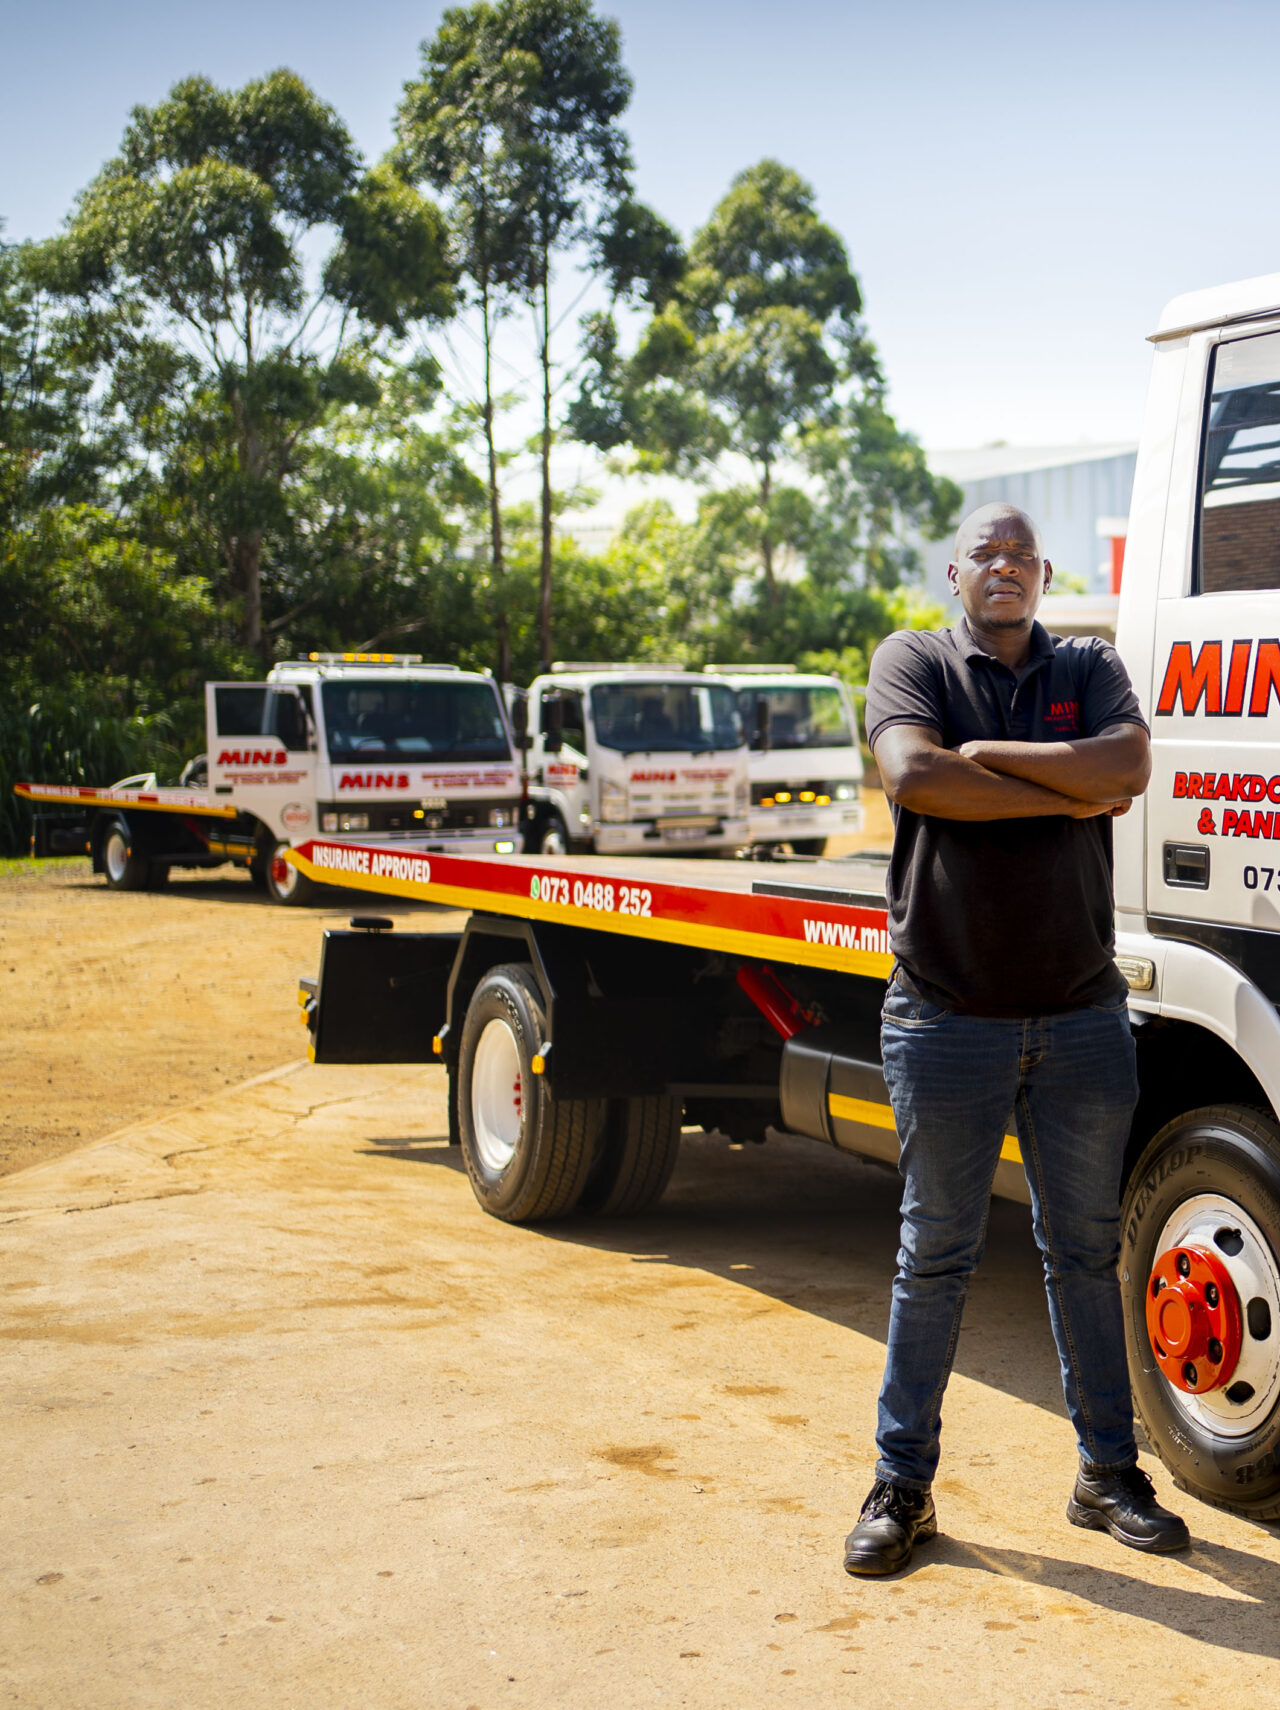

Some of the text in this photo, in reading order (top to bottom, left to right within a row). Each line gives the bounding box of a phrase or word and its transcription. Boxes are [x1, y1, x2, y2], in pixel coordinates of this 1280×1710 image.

[218, 750, 287, 766] MINS
[339, 773, 409, 789] MINS
[1197, 807, 1218, 836] &
[312, 845, 431, 883] INSURANCE APPROVED
[541, 876, 652, 917] 073 0488 252
